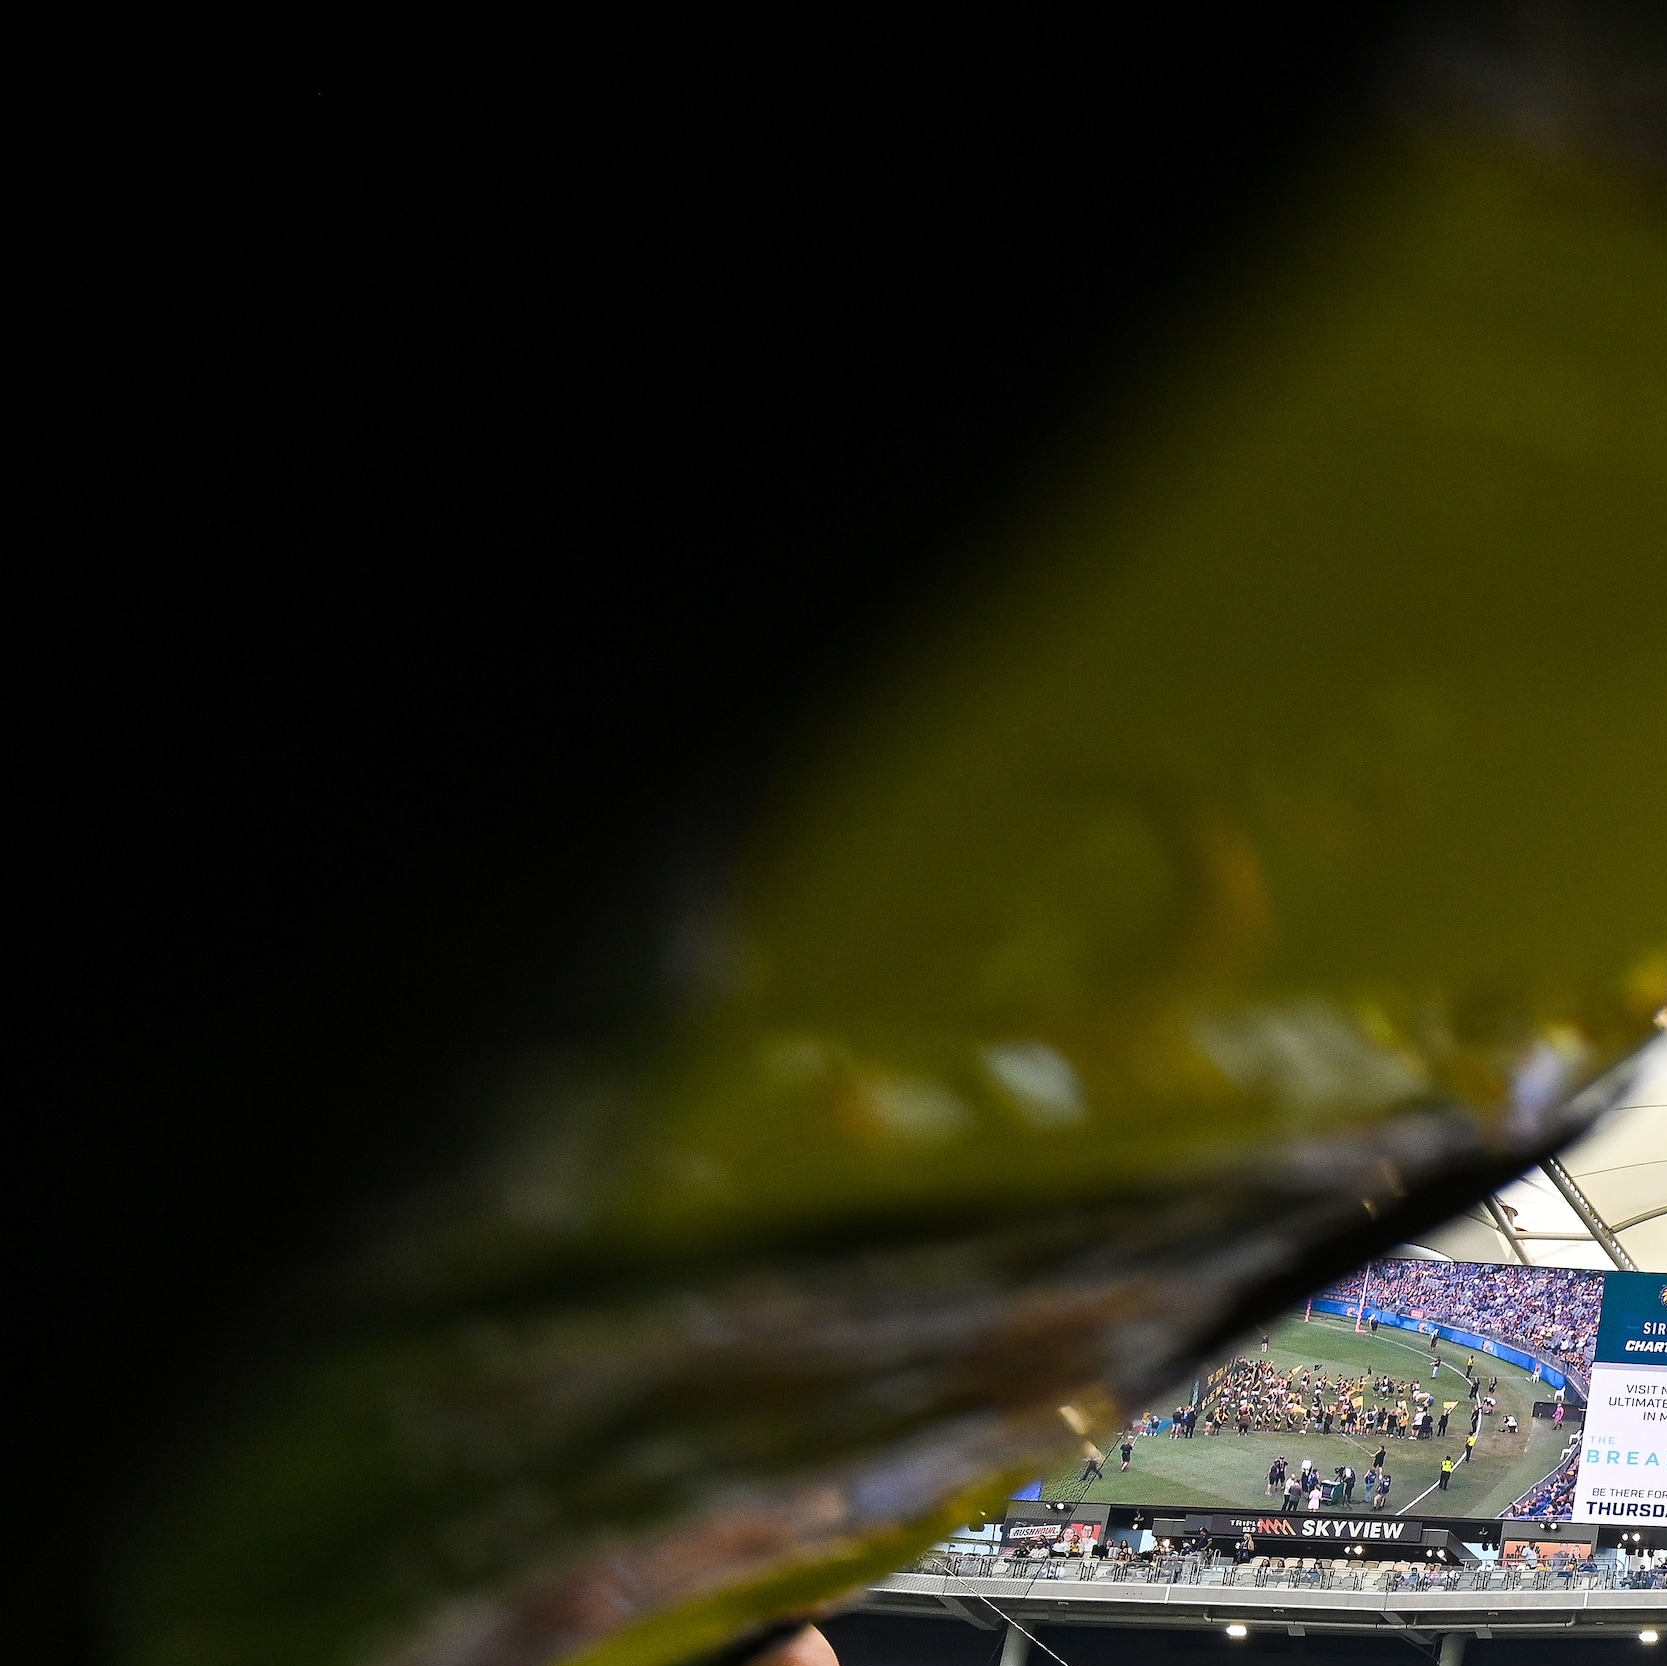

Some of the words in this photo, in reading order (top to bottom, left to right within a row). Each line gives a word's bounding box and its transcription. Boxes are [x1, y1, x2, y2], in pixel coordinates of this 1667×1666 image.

[1626, 1384, 1658, 1395] VISIT
[1643, 1411, 1656, 1421] IN
[1590, 1435, 1615, 1445] THE
[1592, 1488, 1606, 1497] BE
[1609, 1488, 1645, 1499] THERE
[1302, 1520, 1404, 1540] SKYVIEW
